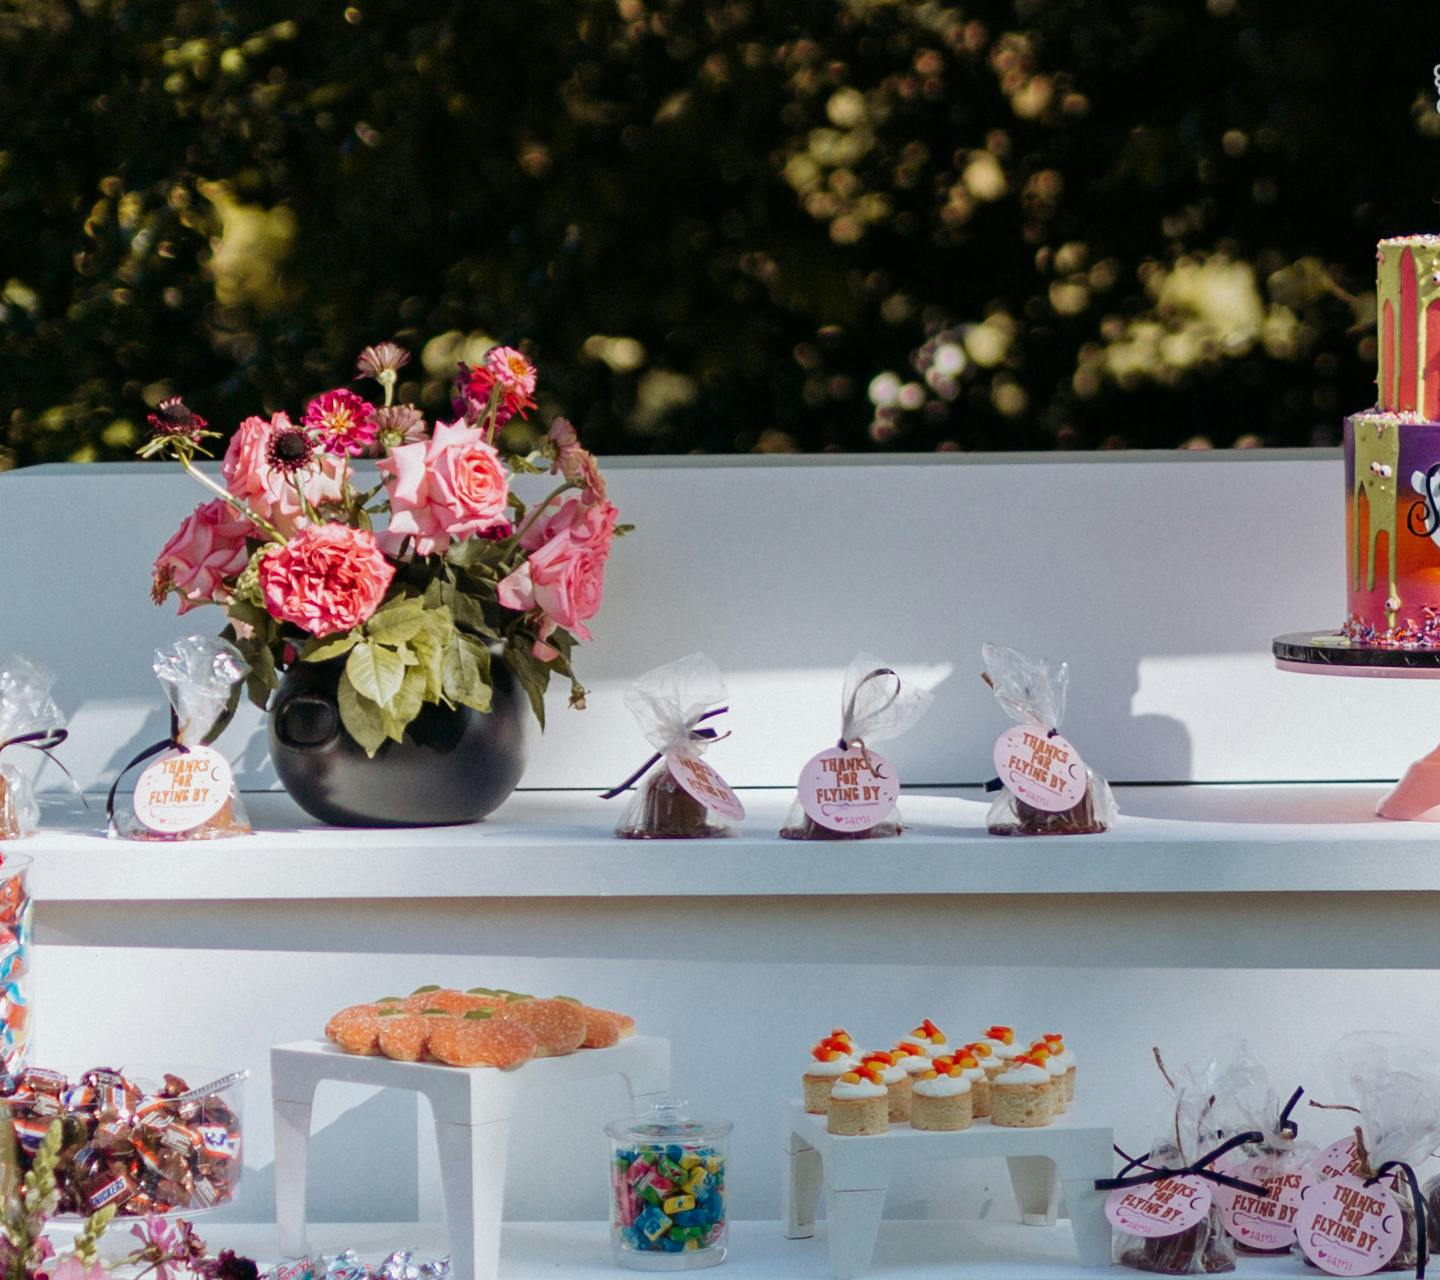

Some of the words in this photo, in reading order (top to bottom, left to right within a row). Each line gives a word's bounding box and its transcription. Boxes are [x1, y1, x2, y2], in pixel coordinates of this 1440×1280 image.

[1023, 732, 1069, 764] THANKS
[162, 759, 210, 774] THANKS
[1031, 751, 1053, 771] FOR
[171, 772, 193, 789] FOR
[836, 771, 858, 787] FOR
[1008, 755, 1048, 783] FLYING
[1049, 774, 1068, 793] BY
[148, 789, 189, 805] FLYING
[192, 787, 209, 802] BY
[816, 786, 859, 804] FLYING
[862, 785, 880, 800] BY
[1148, 1190, 1174, 1206] FOR
[1150, 1177, 1197, 1198] HANKS
[1120, 1194, 1160, 1215] FLYING
[1162, 1206, 1184, 1222] BY
[1231, 1194, 1276, 1216] FLYING
[1277, 1204, 1299, 1223] BY
[1333, 1184, 1386, 1217] THANKS
[1338, 1205, 1365, 1228] FOR
[1311, 1214, 1357, 1243] FLYING
[1356, 1230, 1379, 1252] BY
